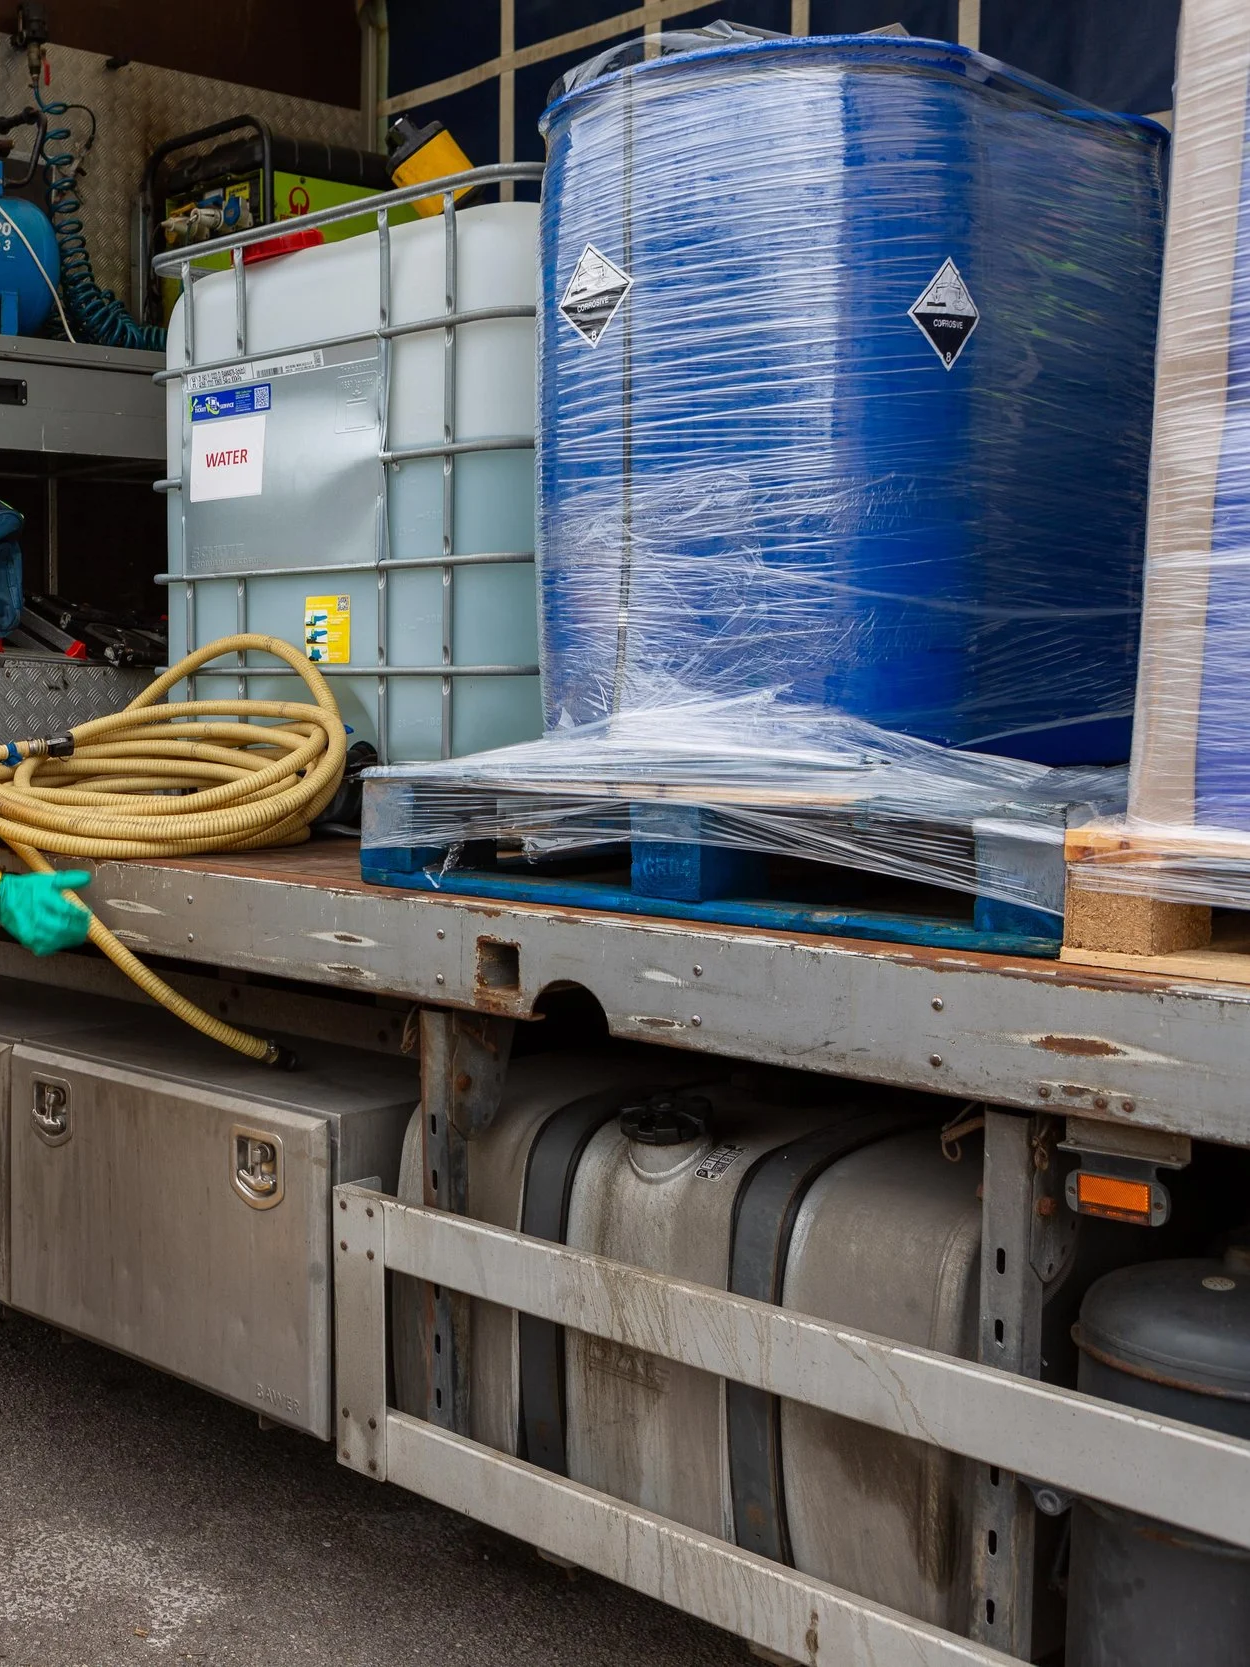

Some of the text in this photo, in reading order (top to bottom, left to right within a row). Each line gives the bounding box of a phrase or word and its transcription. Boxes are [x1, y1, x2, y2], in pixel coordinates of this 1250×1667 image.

[2, 239, 12, 251] 3
[576, 296, 610, 313] CORROSIVE
[591, 330, 597, 341] 8
[945, 351, 952, 363] 8
[205, 448, 248, 469] WATER
